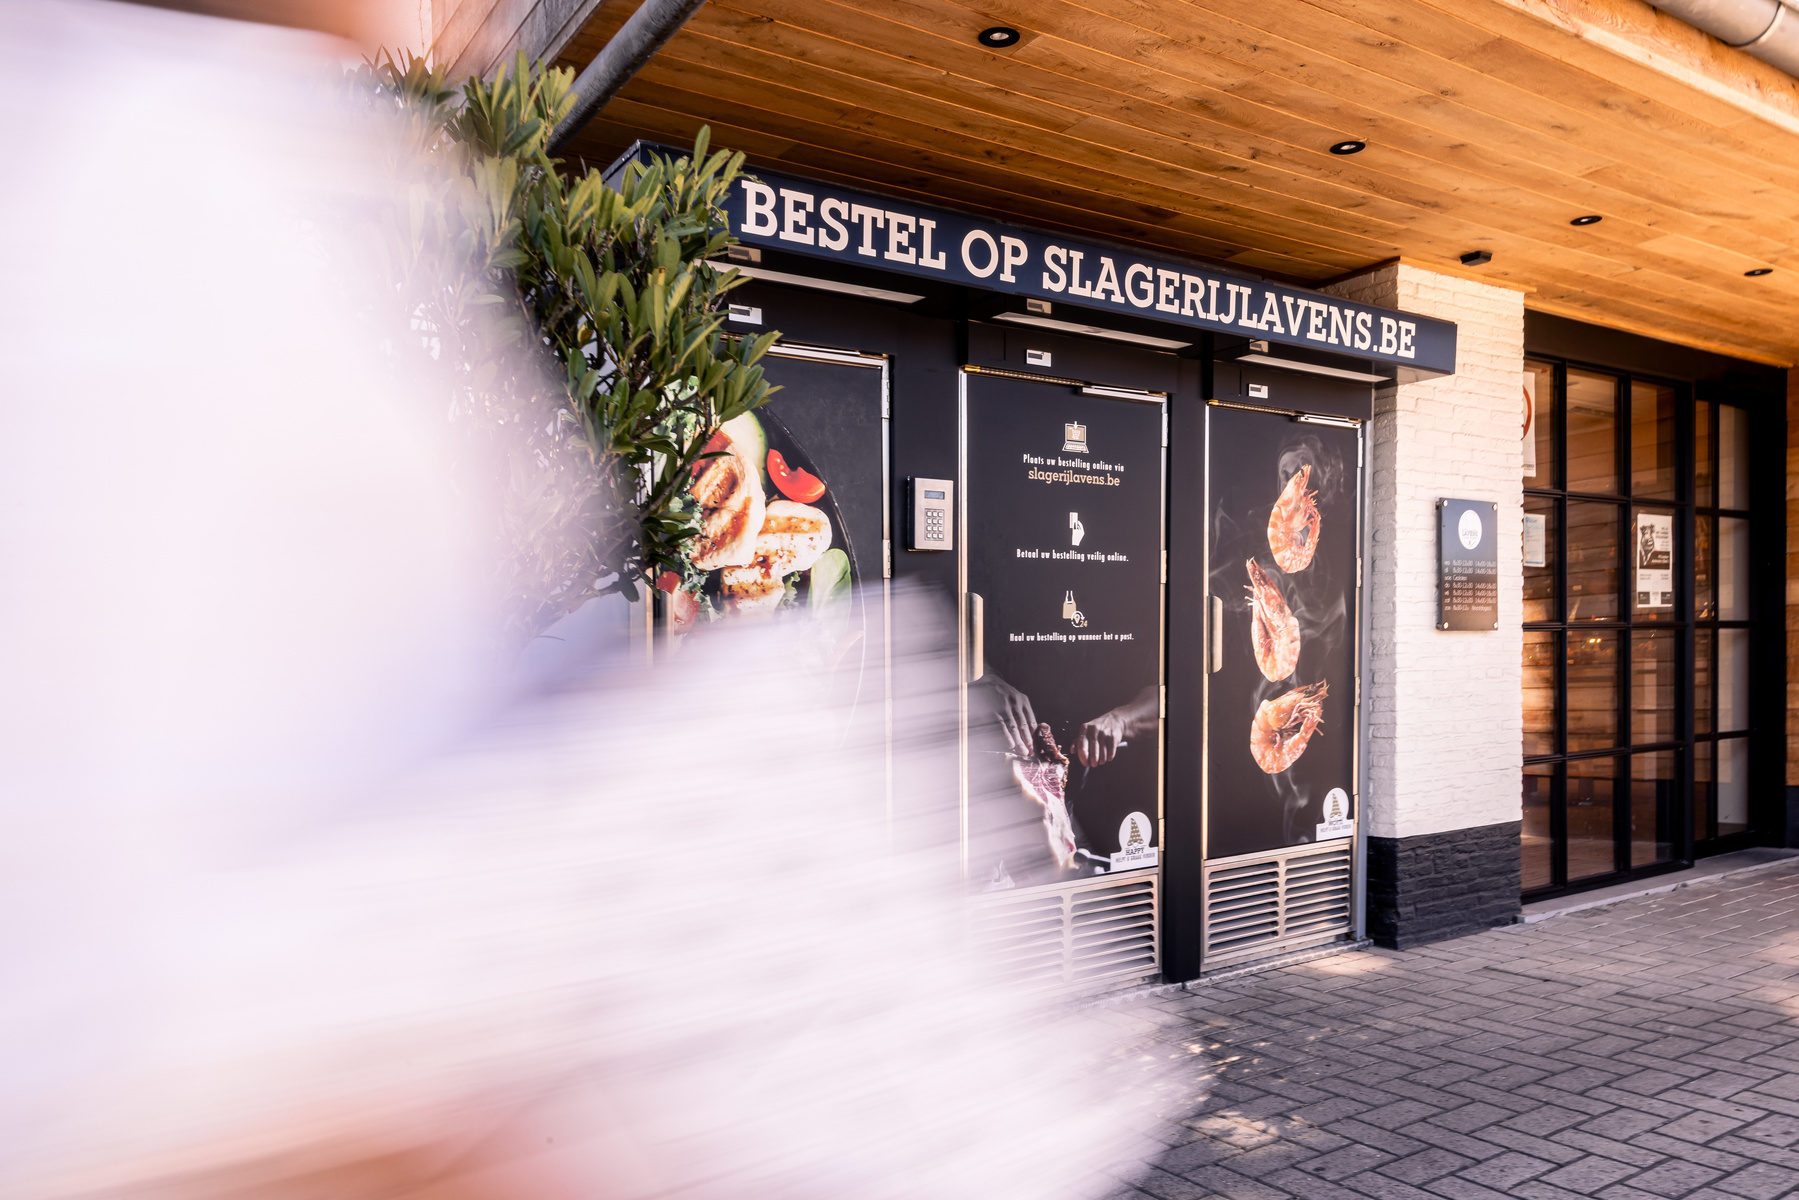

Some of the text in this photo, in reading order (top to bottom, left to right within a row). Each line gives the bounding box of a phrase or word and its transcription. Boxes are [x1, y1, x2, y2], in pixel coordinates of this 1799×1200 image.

[741, 179, 1416, 359] BESTEL OP SLAGERIJLAVENS.BE
[1023, 453, 1124, 472] Plaats uw bestelling online via
[1028, 467, 1120, 486] slagerijlavens.be
[1016, 548, 1039, 559] Betaal
[1052, 549, 1085, 562] bestelling
[1087, 551, 1105, 563] veilig
[1107, 552, 1129, 562] online.
[1009, 632, 1024, 642] Haal
[1036, 632, 1067, 643] bestelling
[1068, 635, 1076, 643] op
[1103, 632, 1113, 641] het
[1120, 633, 1134, 642] past.
